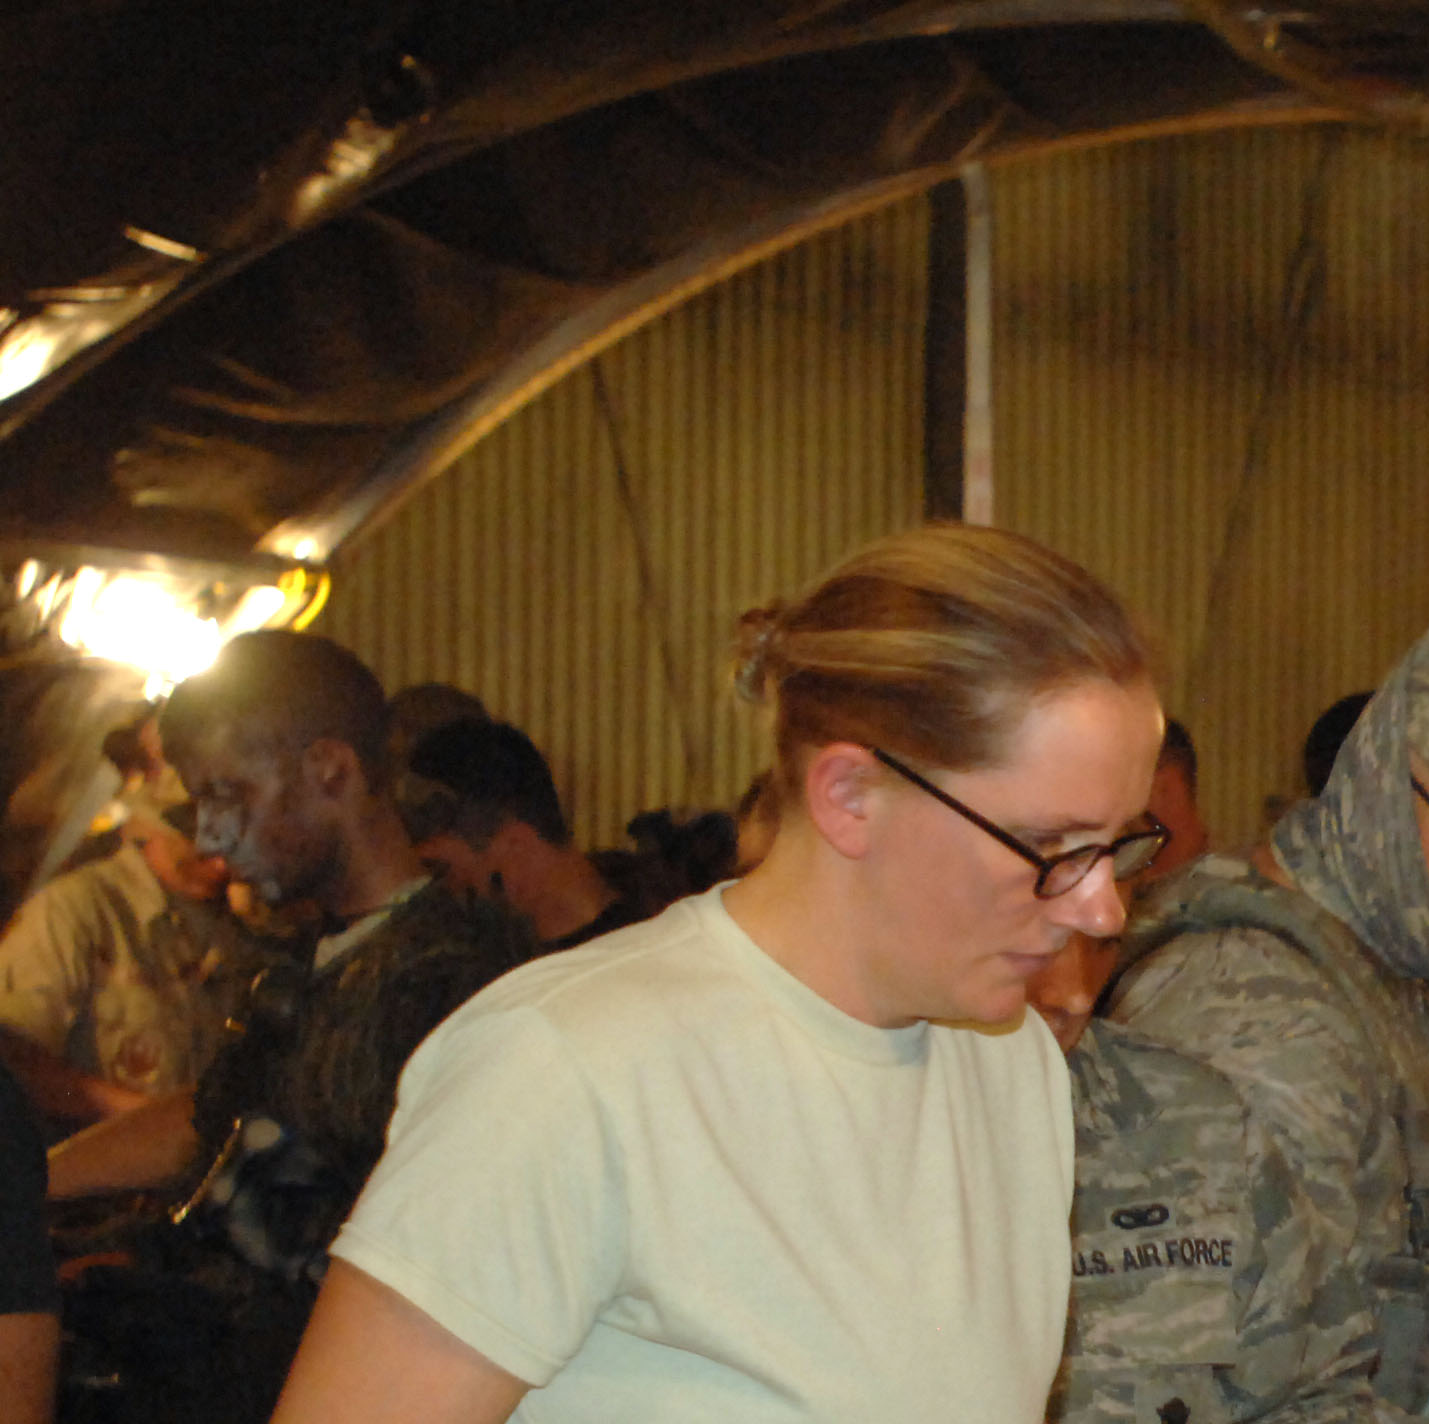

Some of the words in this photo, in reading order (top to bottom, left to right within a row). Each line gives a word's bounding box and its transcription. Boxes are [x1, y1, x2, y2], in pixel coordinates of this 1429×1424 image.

[1072, 1250, 1115, 1276] U.S.
[1123, 1242, 1163, 1272] AIR
[1164, 1237, 1233, 1268] FORCE
